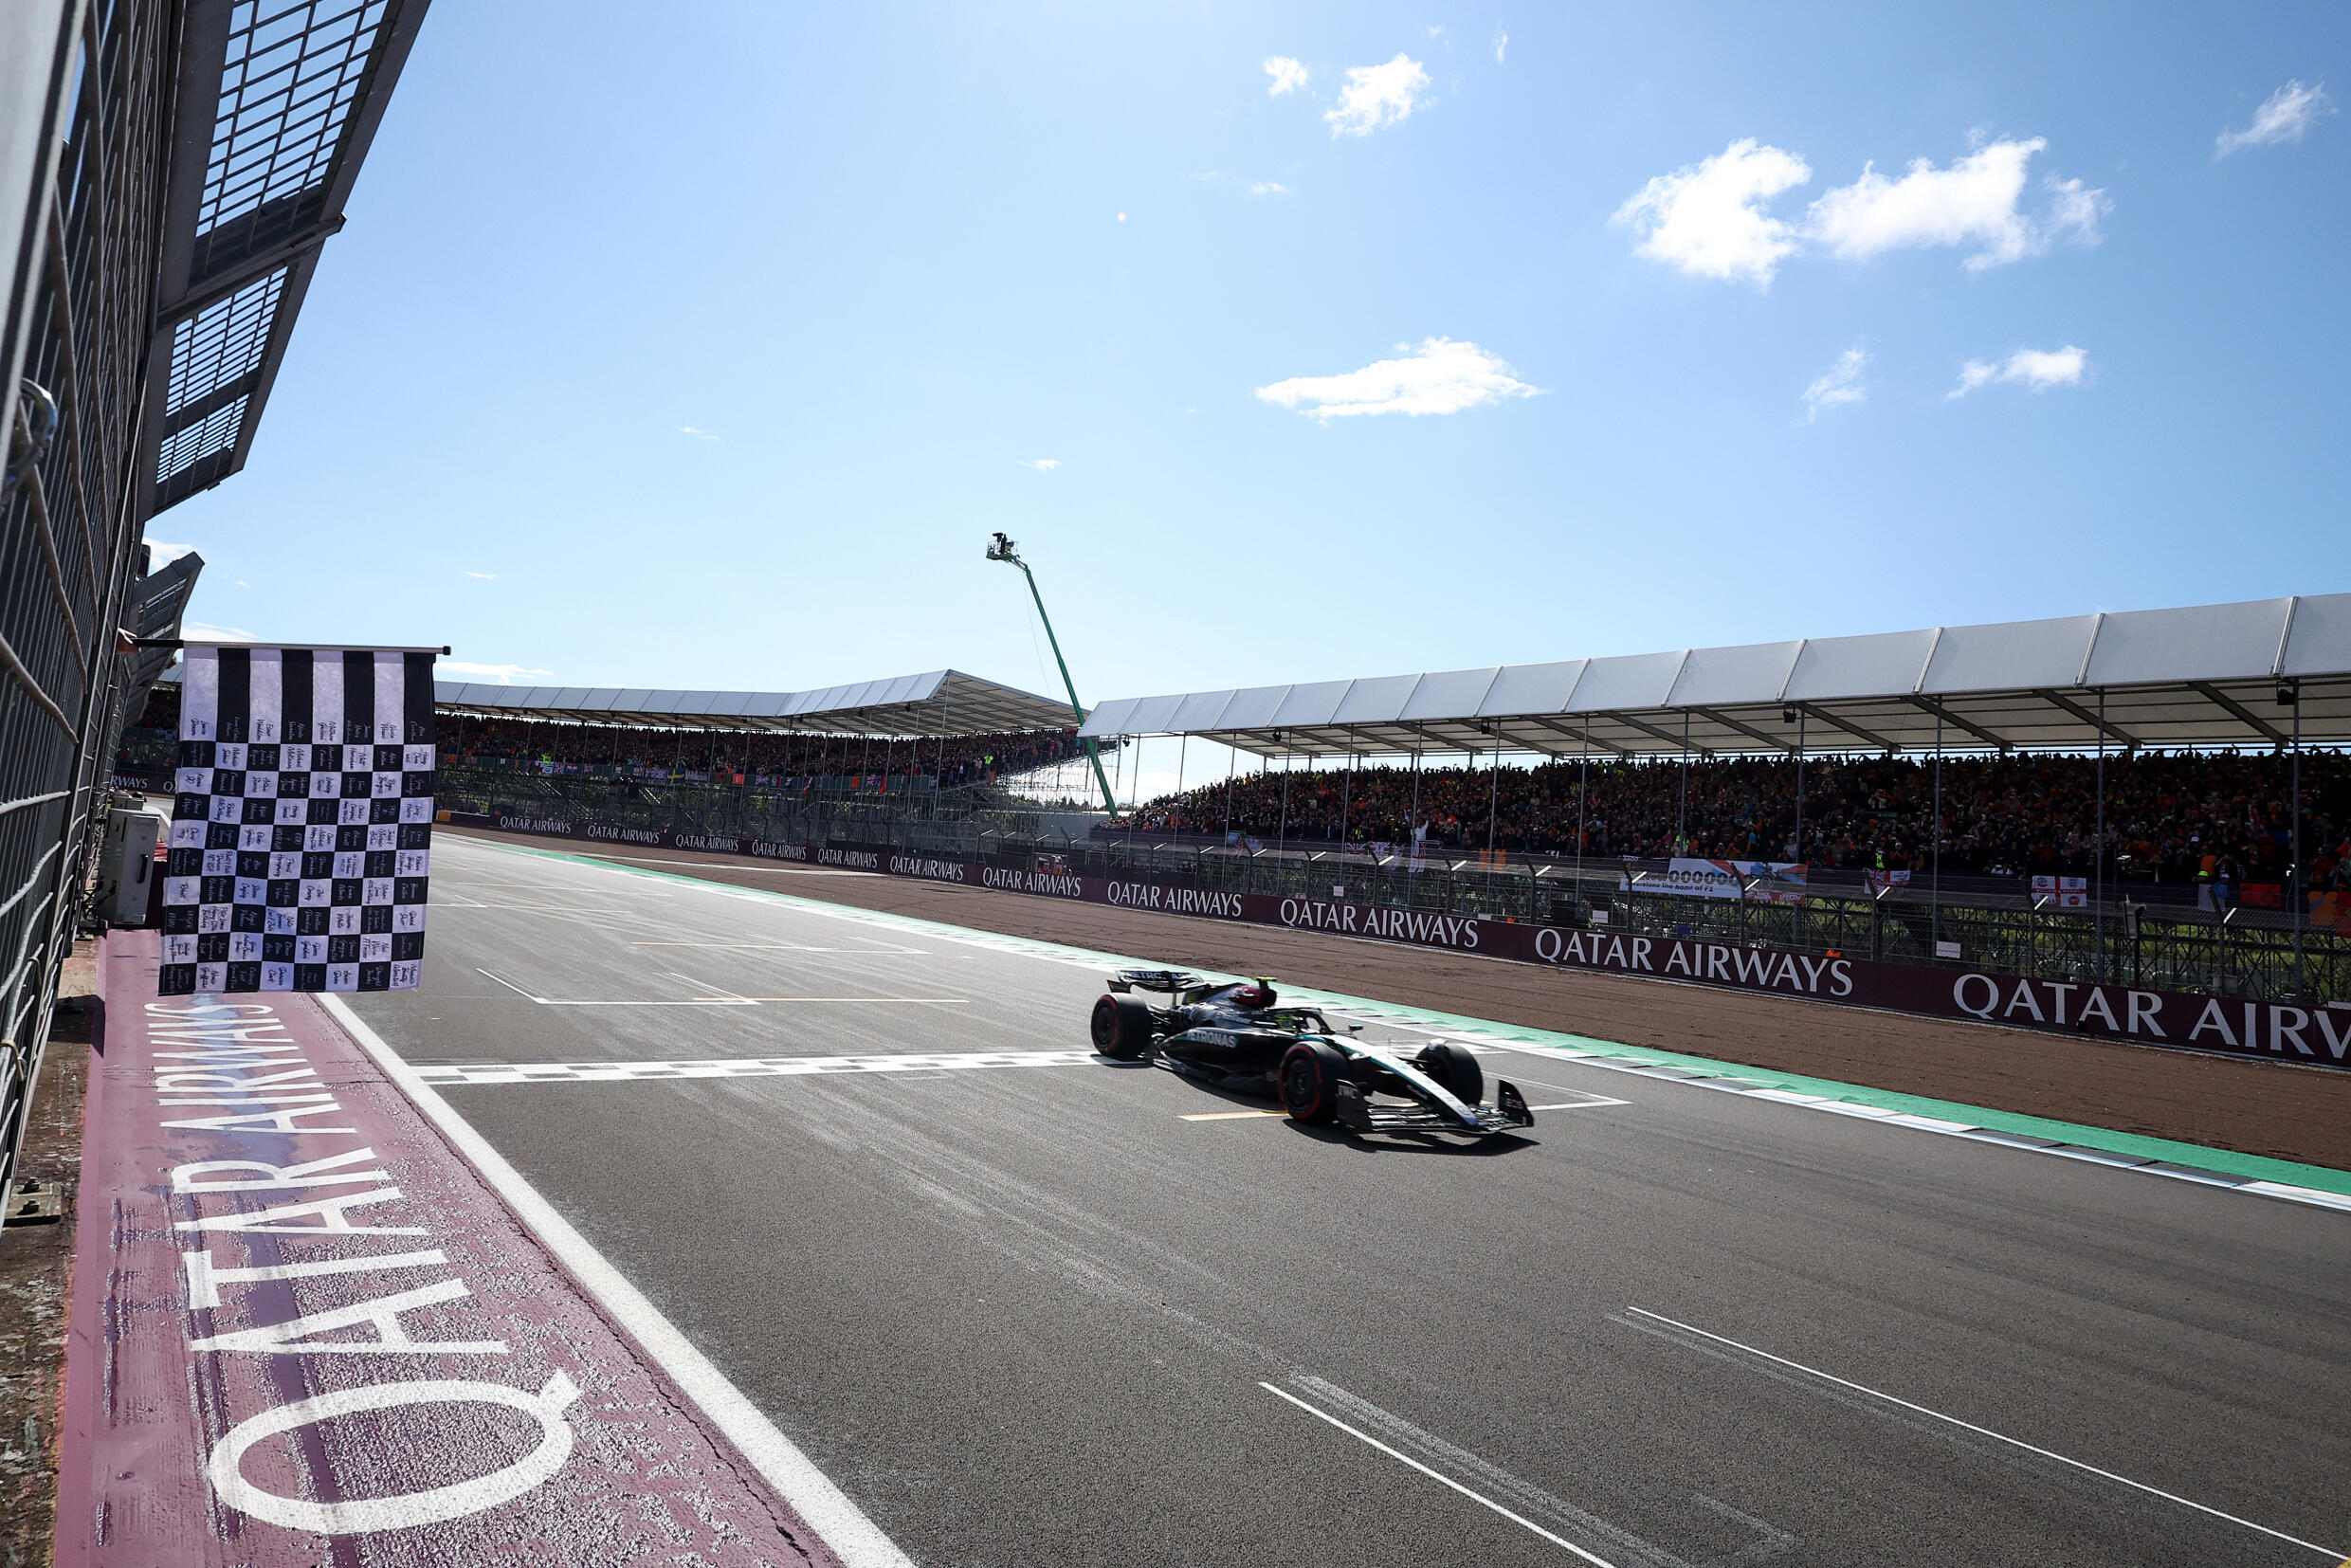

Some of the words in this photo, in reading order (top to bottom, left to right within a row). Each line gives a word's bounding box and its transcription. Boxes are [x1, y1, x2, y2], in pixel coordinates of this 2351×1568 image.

[501, 816, 530, 830] QATAR
[533, 819, 571, 834] AIRWAYS
[588, 825, 618, 839] QATAR
[621, 829, 659, 844] AIRWAYS
[676, 834, 704, 848] QATAR
[707, 837, 738, 851] AIRWAYS
[752, 842, 775, 857] QATAR
[777, 845, 806, 860] AIRWAYS
[818, 848, 842, 865] QATAR
[844, 851, 878, 868] AIRWAYS
[890, 855, 921, 873] QATAR
[923, 860, 963, 881] AIRWAYS
[983, 866, 1022, 889] QATAR
[1025, 872, 1081, 897] AIRWAYS
[1107, 881, 1160, 907] QATAR
[1164, 888, 1243, 917] AIRWAYS
[1280, 899, 1357, 931] QATAR
[1363, 909, 1478, 948] AIRWAYS
[1535, 929, 1653, 971] QATAR
[1665, 941, 1853, 996] AIRWAYS
[1953, 974, 2167, 1037] QATAR
[144, 1002, 357, 1134] AIRWAYS
[172, 1147, 582, 1535] QATAR
